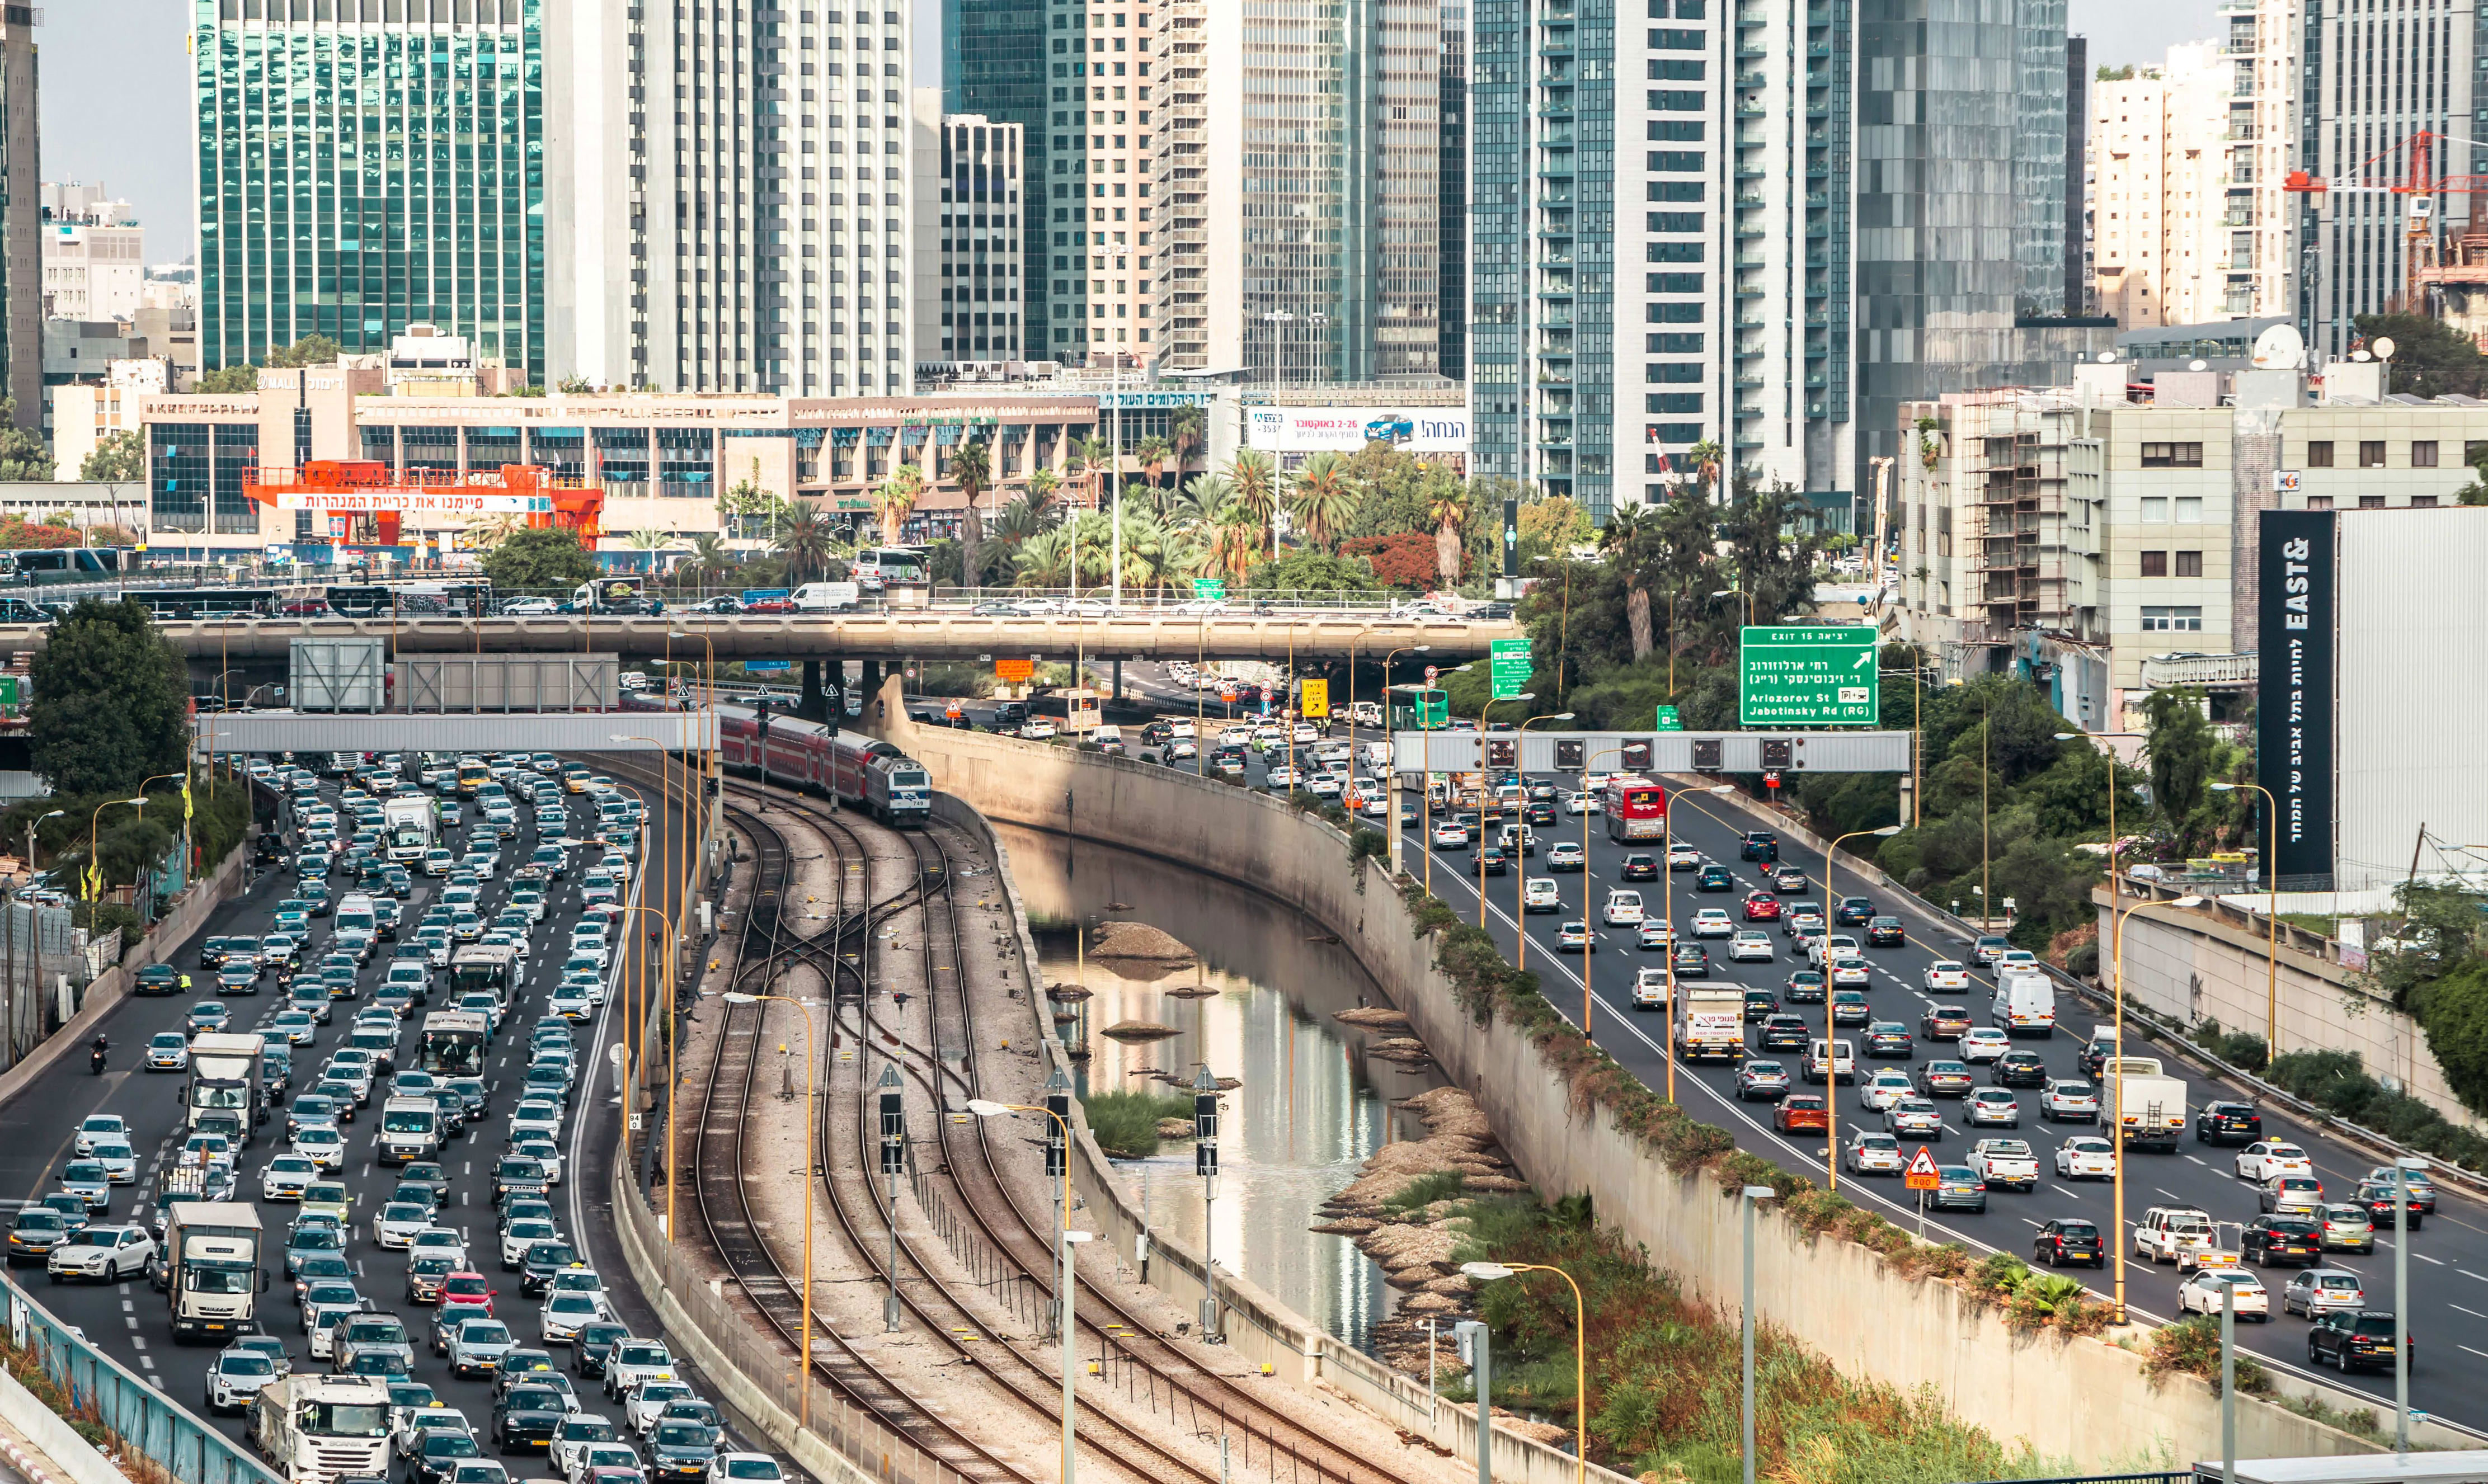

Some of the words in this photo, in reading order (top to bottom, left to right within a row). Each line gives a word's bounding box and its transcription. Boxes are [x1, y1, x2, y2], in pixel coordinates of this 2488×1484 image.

[308, 377, 345, 390] דימול
[1147, 393, 1195, 406] היהלומים
[1294, 420, 1334, 429] באוקטובר
[1421, 419, 1465, 438] הנחה!
[2280, 474, 2298, 488] HUGE
[305, 496, 366, 508] המנהרות
[372, 496, 409, 508] כריית
[442, 497, 483, 509] סיימנו
[2283, 538, 2309, 630] EAST&
[1749, 661, 1804, 670] ארלוזורוב
[2289, 639, 2302, 685] לחיות
[1749, 694, 1809, 703] Arlozorov
[1816, 694, 1829, 703] St
[1749, 706, 1817, 717] Jabotinsky
[1823, 706, 1837, 715] Rd
[1843, 706, 1869, 717] (RG)
[2289, 690, 2302, 722] בתל
[2291, 727, 2302, 766] אביב
[2289, 771, 2301, 793] של
[2291, 797, 2302, 842] המחר
